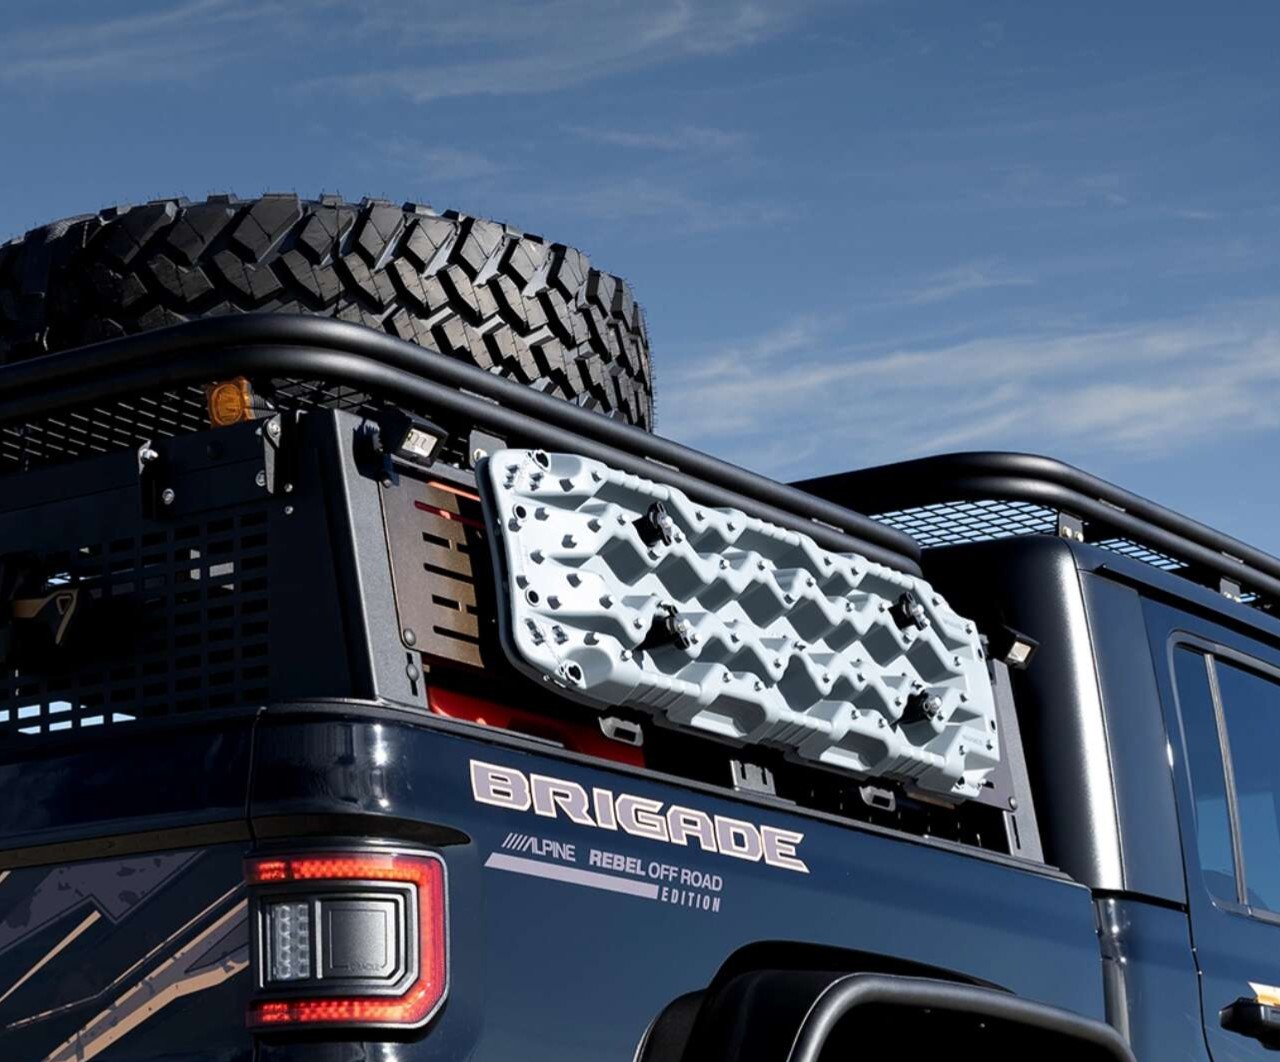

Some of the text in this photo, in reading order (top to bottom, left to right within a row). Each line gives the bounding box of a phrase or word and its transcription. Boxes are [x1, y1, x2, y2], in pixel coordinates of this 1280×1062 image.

[469, 759, 810, 874] BRIGADE
[589, 849, 646, 877] REBEL
[648, 862, 679, 883] OFF
[680, 869, 723, 892] ROAD
[661, 887, 720, 912] EDITION
